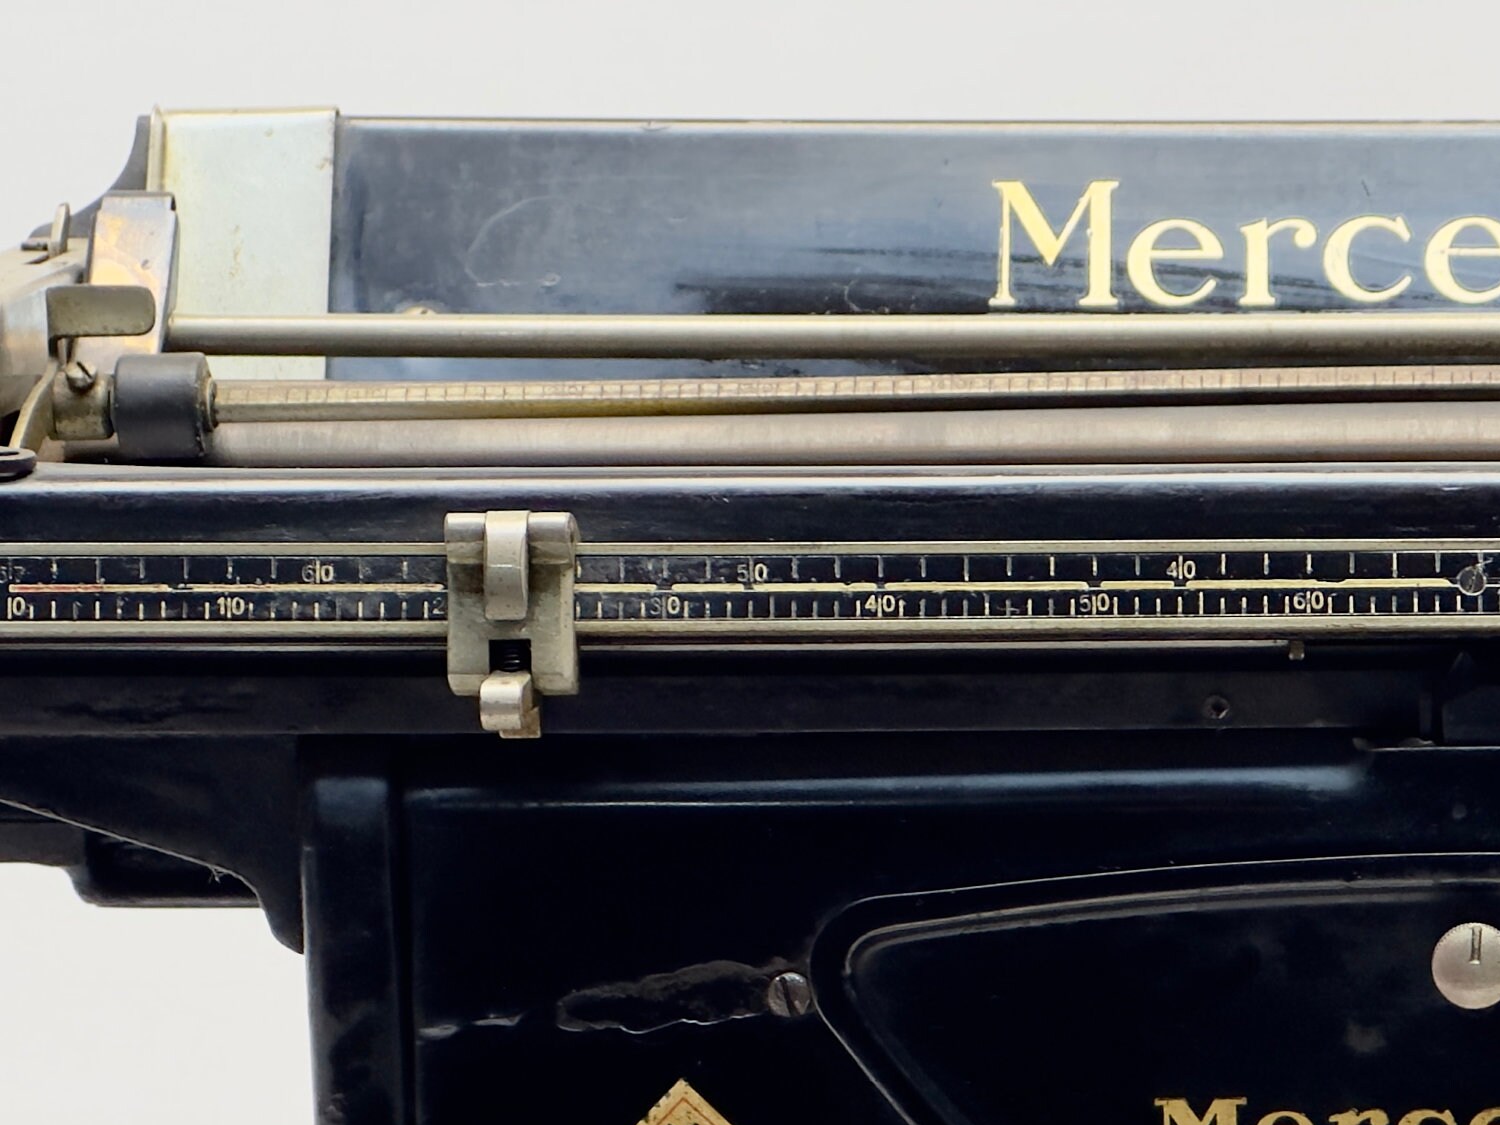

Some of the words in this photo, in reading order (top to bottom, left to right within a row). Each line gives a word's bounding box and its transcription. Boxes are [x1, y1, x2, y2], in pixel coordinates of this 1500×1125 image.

[737, 563, 768, 583] 50
[1166, 559, 1195, 577] 40
[217, 596, 244, 616] 10
[865, 595, 895, 612] 40
[1080, 594, 1110, 612] 50
[1293, 591, 1324, 609] 60
